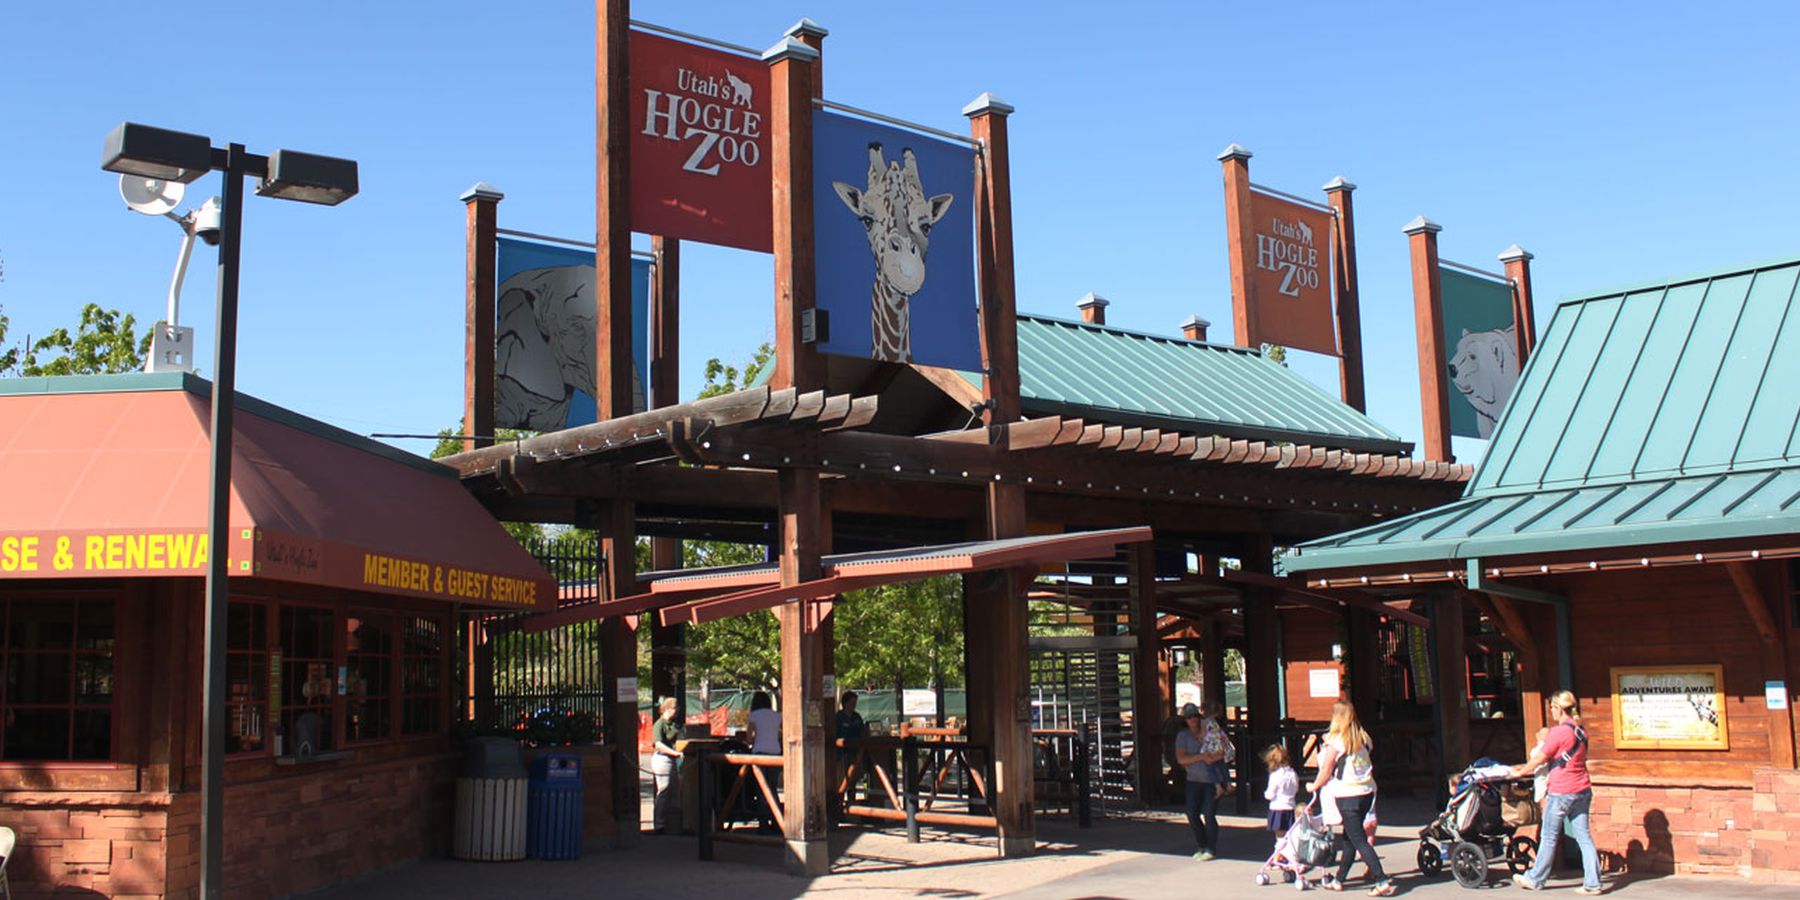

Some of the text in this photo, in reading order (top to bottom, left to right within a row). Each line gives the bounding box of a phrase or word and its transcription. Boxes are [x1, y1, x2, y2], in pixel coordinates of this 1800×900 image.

[678, 68, 731, 100] Utah's
[642, 88, 762, 141] HOGLE
[682, 127, 760, 176] ZOO
[1272, 217, 1301, 240] Utah's
[1256, 233, 1318, 272] HOGLE
[1278, 261, 1319, 297] ZOO
[53, 536, 74, 571] &
[85, 533, 232, 570] RENEWA
[364, 553, 537, 605] MEMBER & GUEST SERVICE
[1622, 685, 1715, 695] ADVENTURES AWAIT
